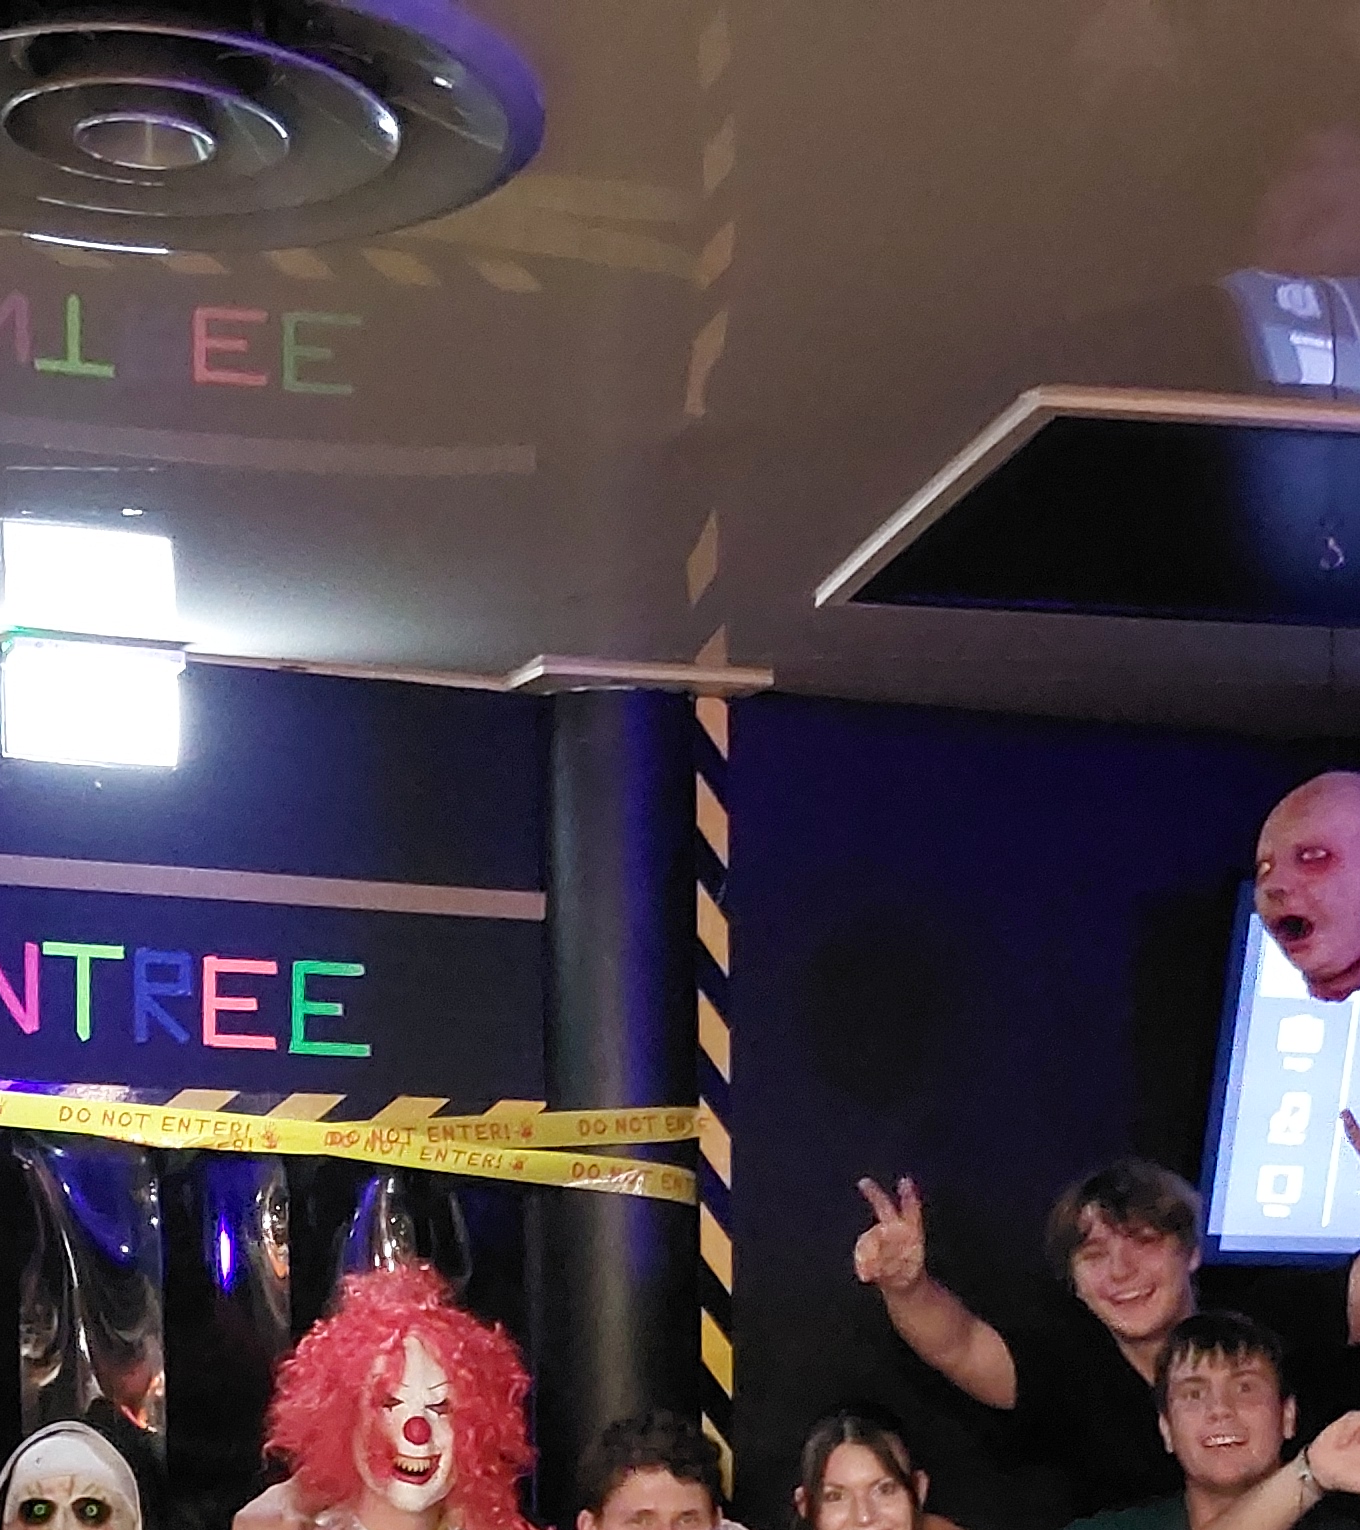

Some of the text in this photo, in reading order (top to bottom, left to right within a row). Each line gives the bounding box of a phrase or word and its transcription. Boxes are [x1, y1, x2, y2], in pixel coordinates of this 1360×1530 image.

[59, 1105, 253, 1139] DO NOT ENTER!
[578, 1118, 607, 1136] DO
[615, 1115, 658, 1135] NOT
[371, 1127, 416, 1144] NOT
[427, 1123, 510, 1143] ENTER!
[420, 1146, 503, 1169] ENTER!
[571, 1161, 600, 1179] DO
